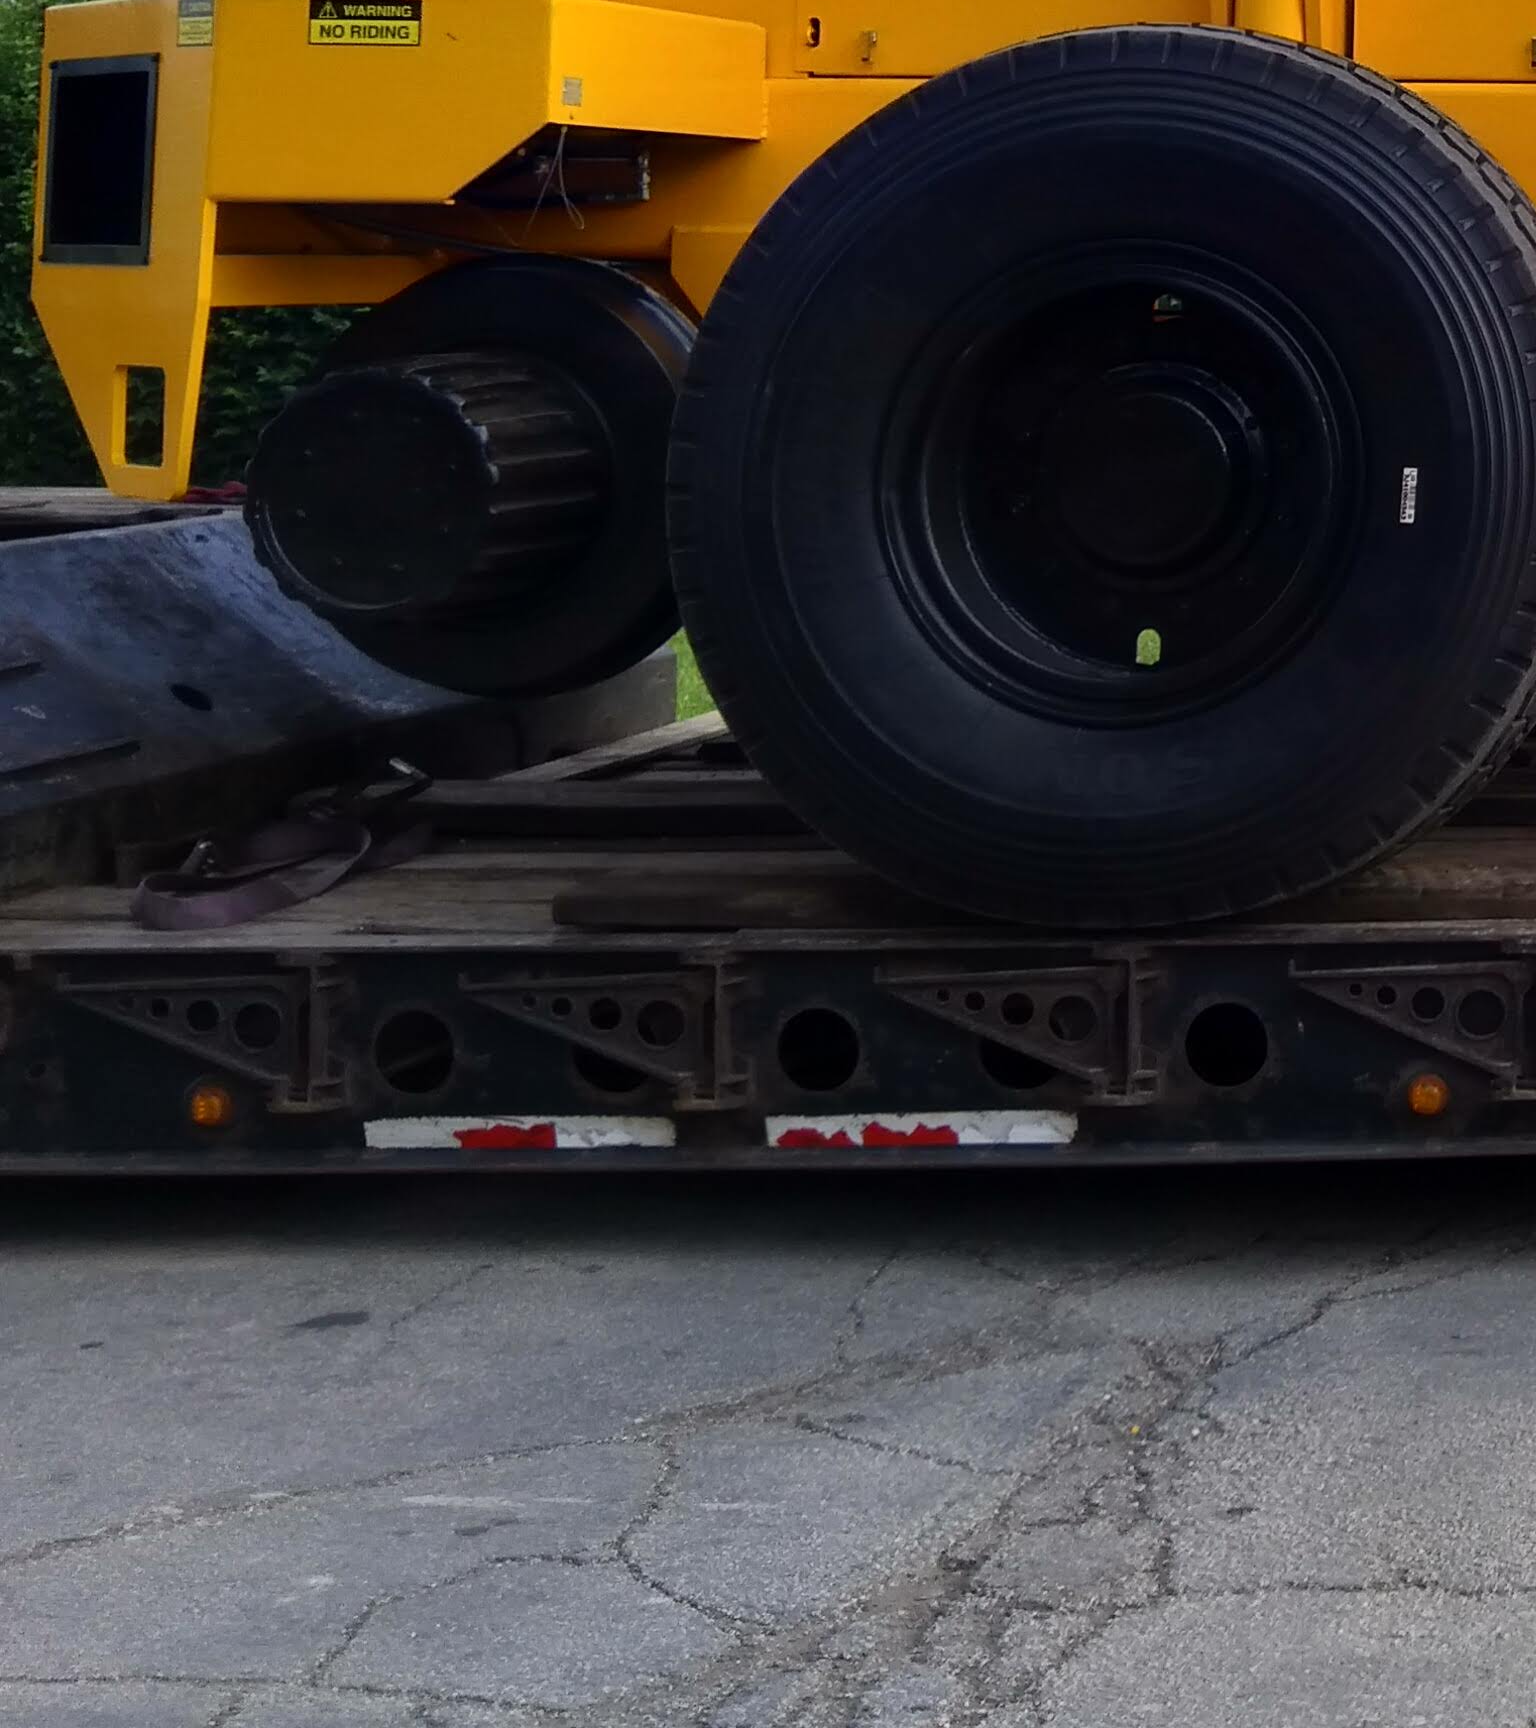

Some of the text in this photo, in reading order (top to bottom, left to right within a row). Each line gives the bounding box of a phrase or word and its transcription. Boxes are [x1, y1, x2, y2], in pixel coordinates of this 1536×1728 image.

[343, 4, 413, 18] WARNING
[319, 24, 410, 39] NO RIDING
